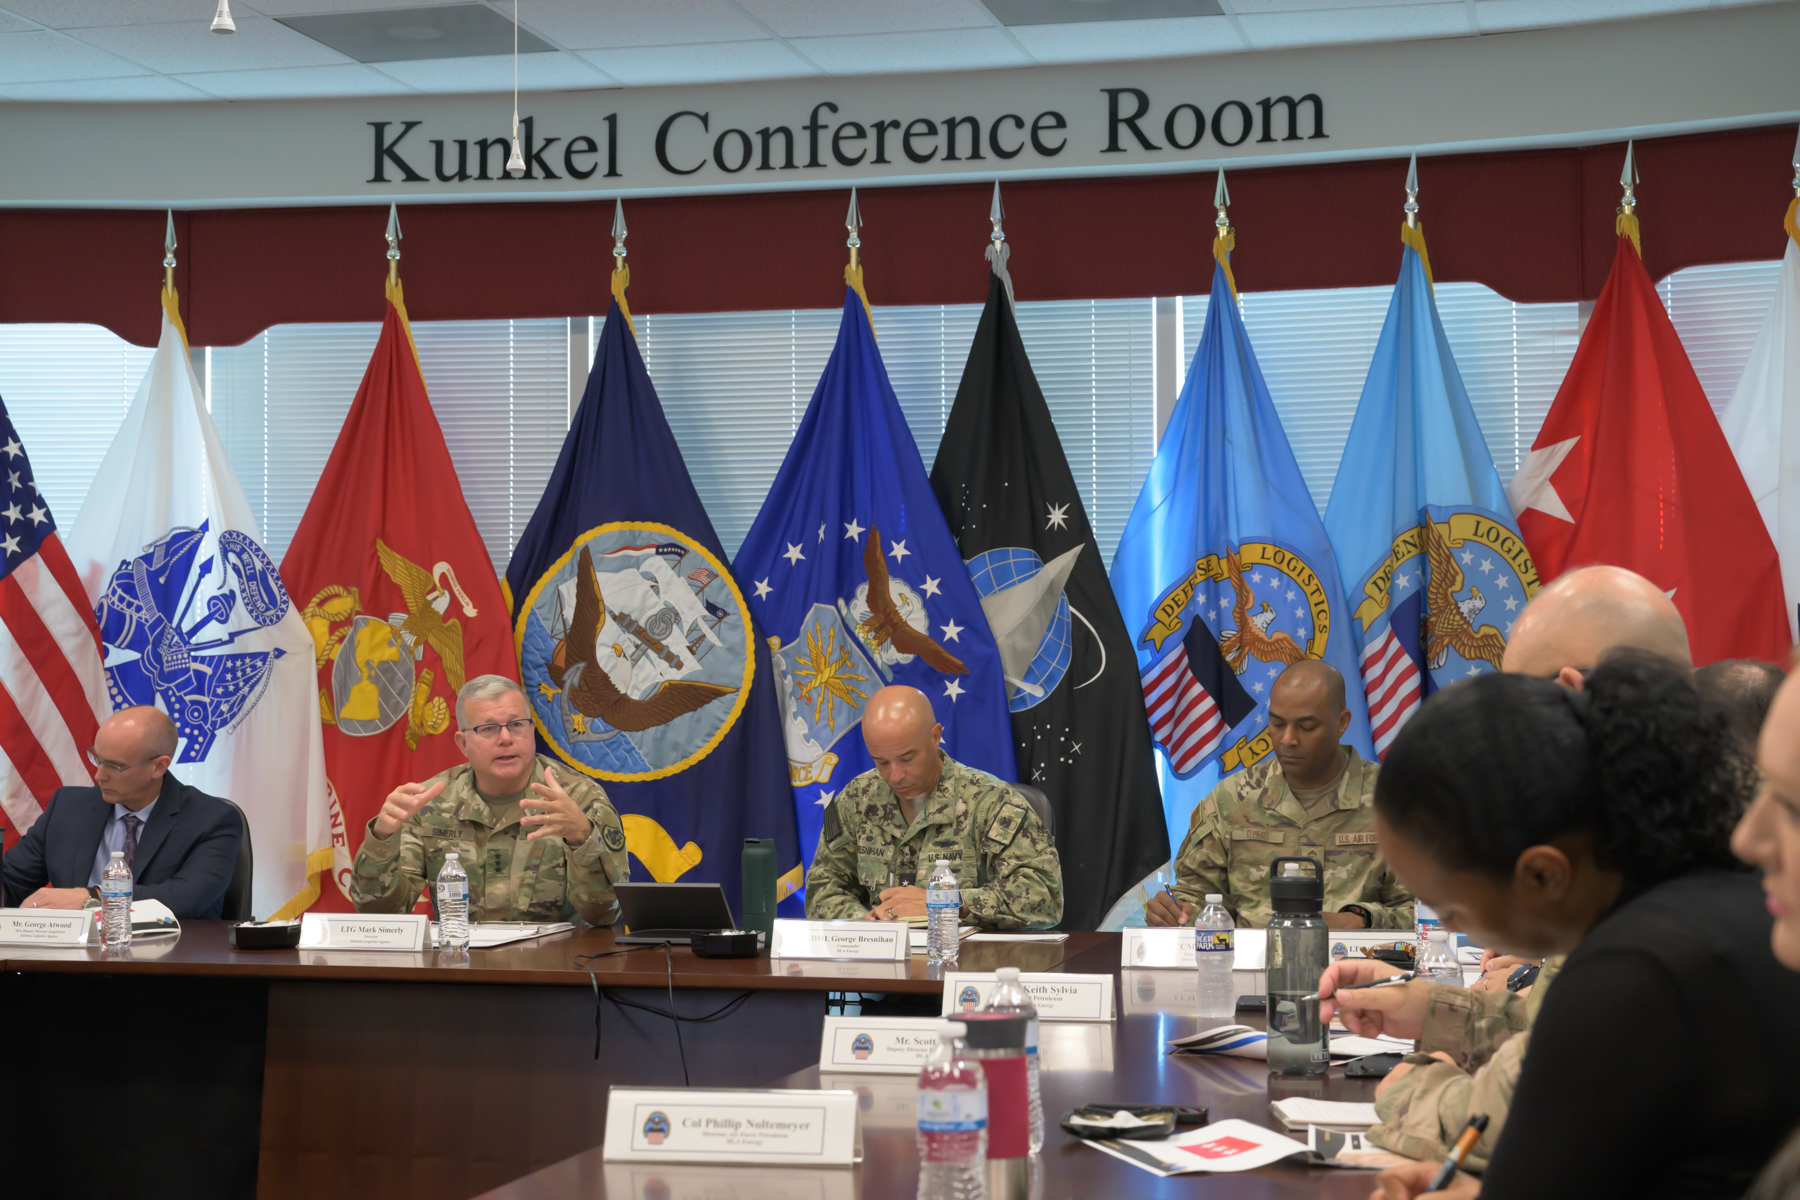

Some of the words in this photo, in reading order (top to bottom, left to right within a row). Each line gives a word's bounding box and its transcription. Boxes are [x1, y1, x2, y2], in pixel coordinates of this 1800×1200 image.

[366, 112, 623, 183] Kunkel
[655, 101, 1068, 176] Conference
[1099, 87, 1330, 153] Room
[1472, 520, 1542, 592] LOGIST
[225, 542, 242, 552] THIS
[248, 581, 266, 612] DEFEND
[1160, 559, 1214, 618] DEFESE
[1260, 546, 1329, 634] LOGISTICS
[431, 827, 464, 838] SIMERLY
[1352, 834, 1364, 843] AIR
[942, 852, 963, 862] NAVY
[24, 921, 47, 929] George
[358, 926, 377, 934] Mark
[378, 926, 405, 935] Simerly
[831, 935, 856, 943] George
[858, 935, 894, 943] Bresnihan
[1023, 985, 1048, 994] Keith
[1050, 985, 1078, 995] Sylvia
[895, 1037, 912, 1045] Mr.
[914, 1037, 936, 1046] Scott
[1313, 1051, 1329, 1060] YETI
[682, 1117, 702, 1129] Col
[705, 1117, 742, 1131] Phillip
[745, 1118, 811, 1133] Noltemeyer
